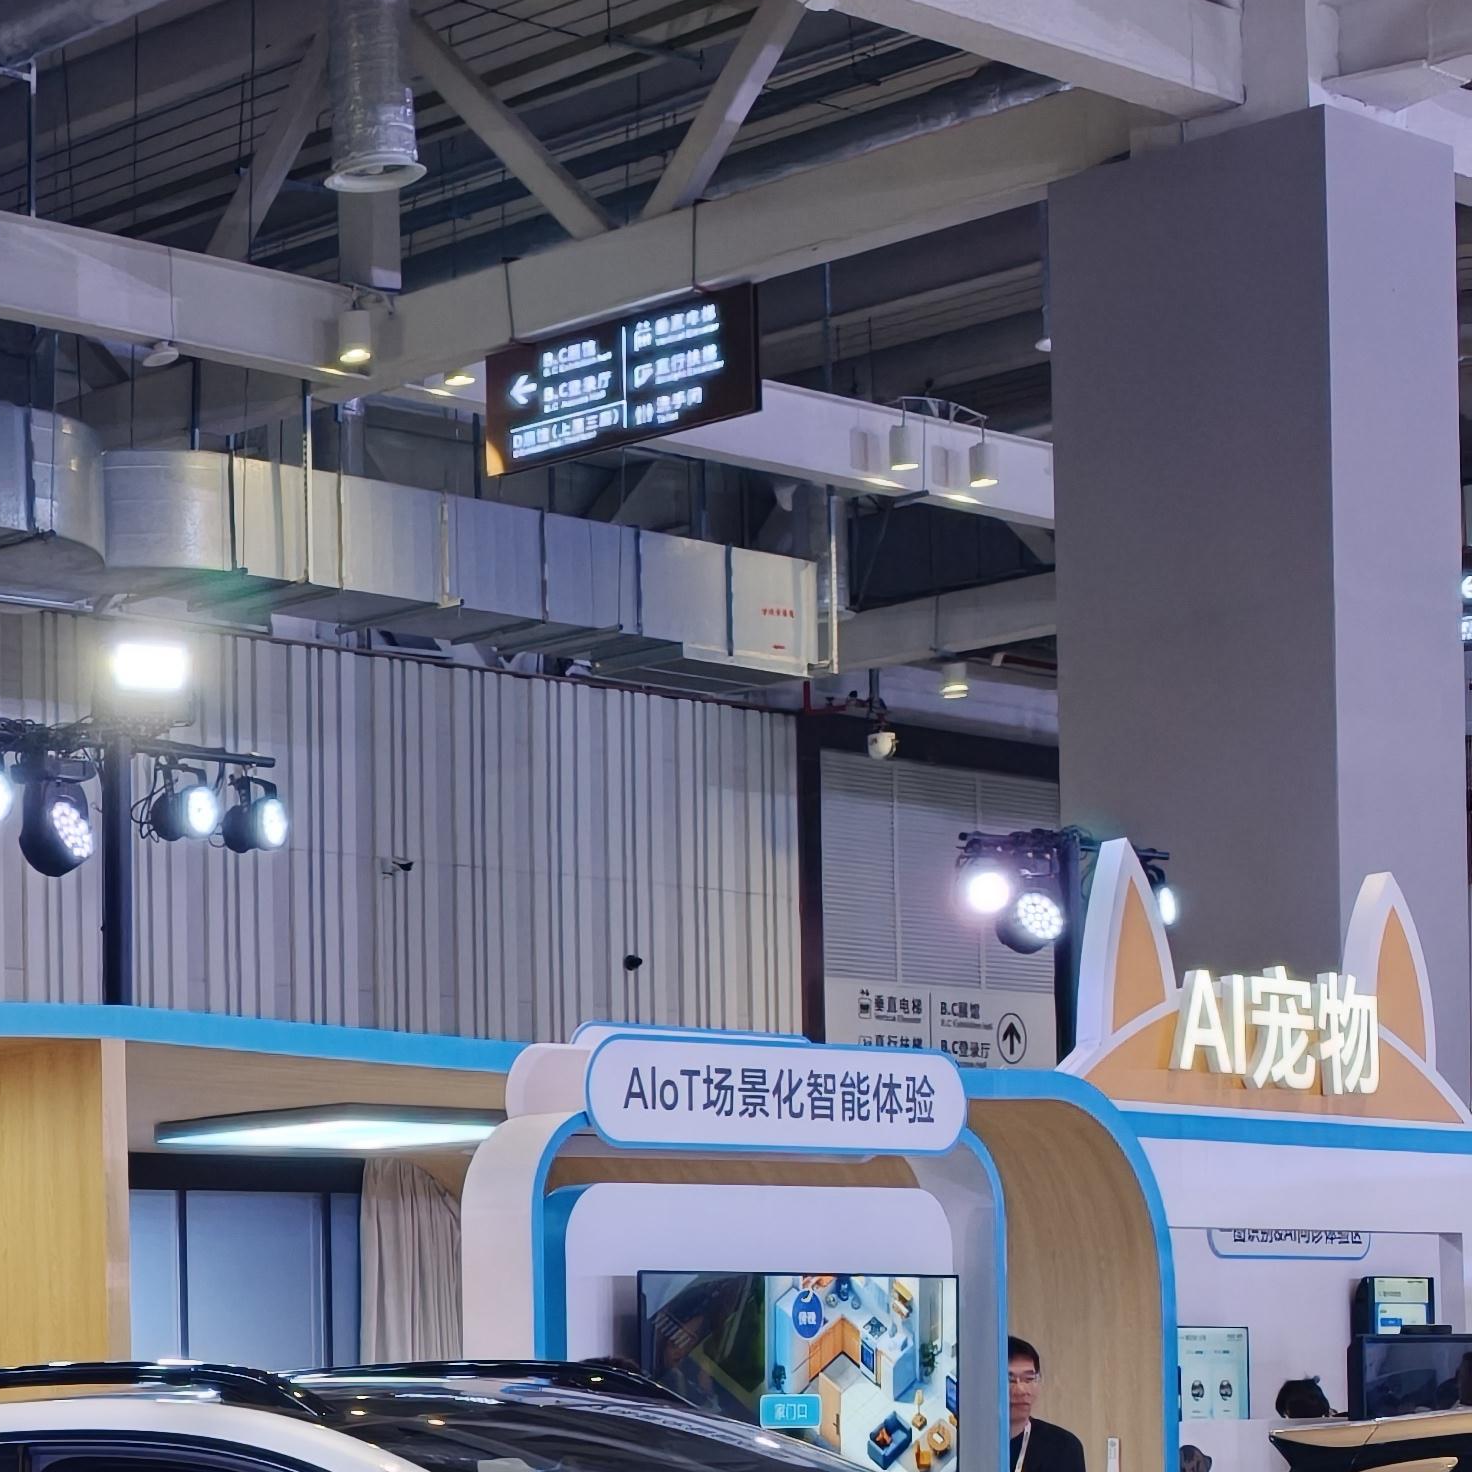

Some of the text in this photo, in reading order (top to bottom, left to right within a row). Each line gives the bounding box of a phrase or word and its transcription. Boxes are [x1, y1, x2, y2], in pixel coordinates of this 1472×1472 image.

[1170, 966, 1380, 1095] AI宠物
[622, 1064, 935, 1125] AIoT场景化智能体验
